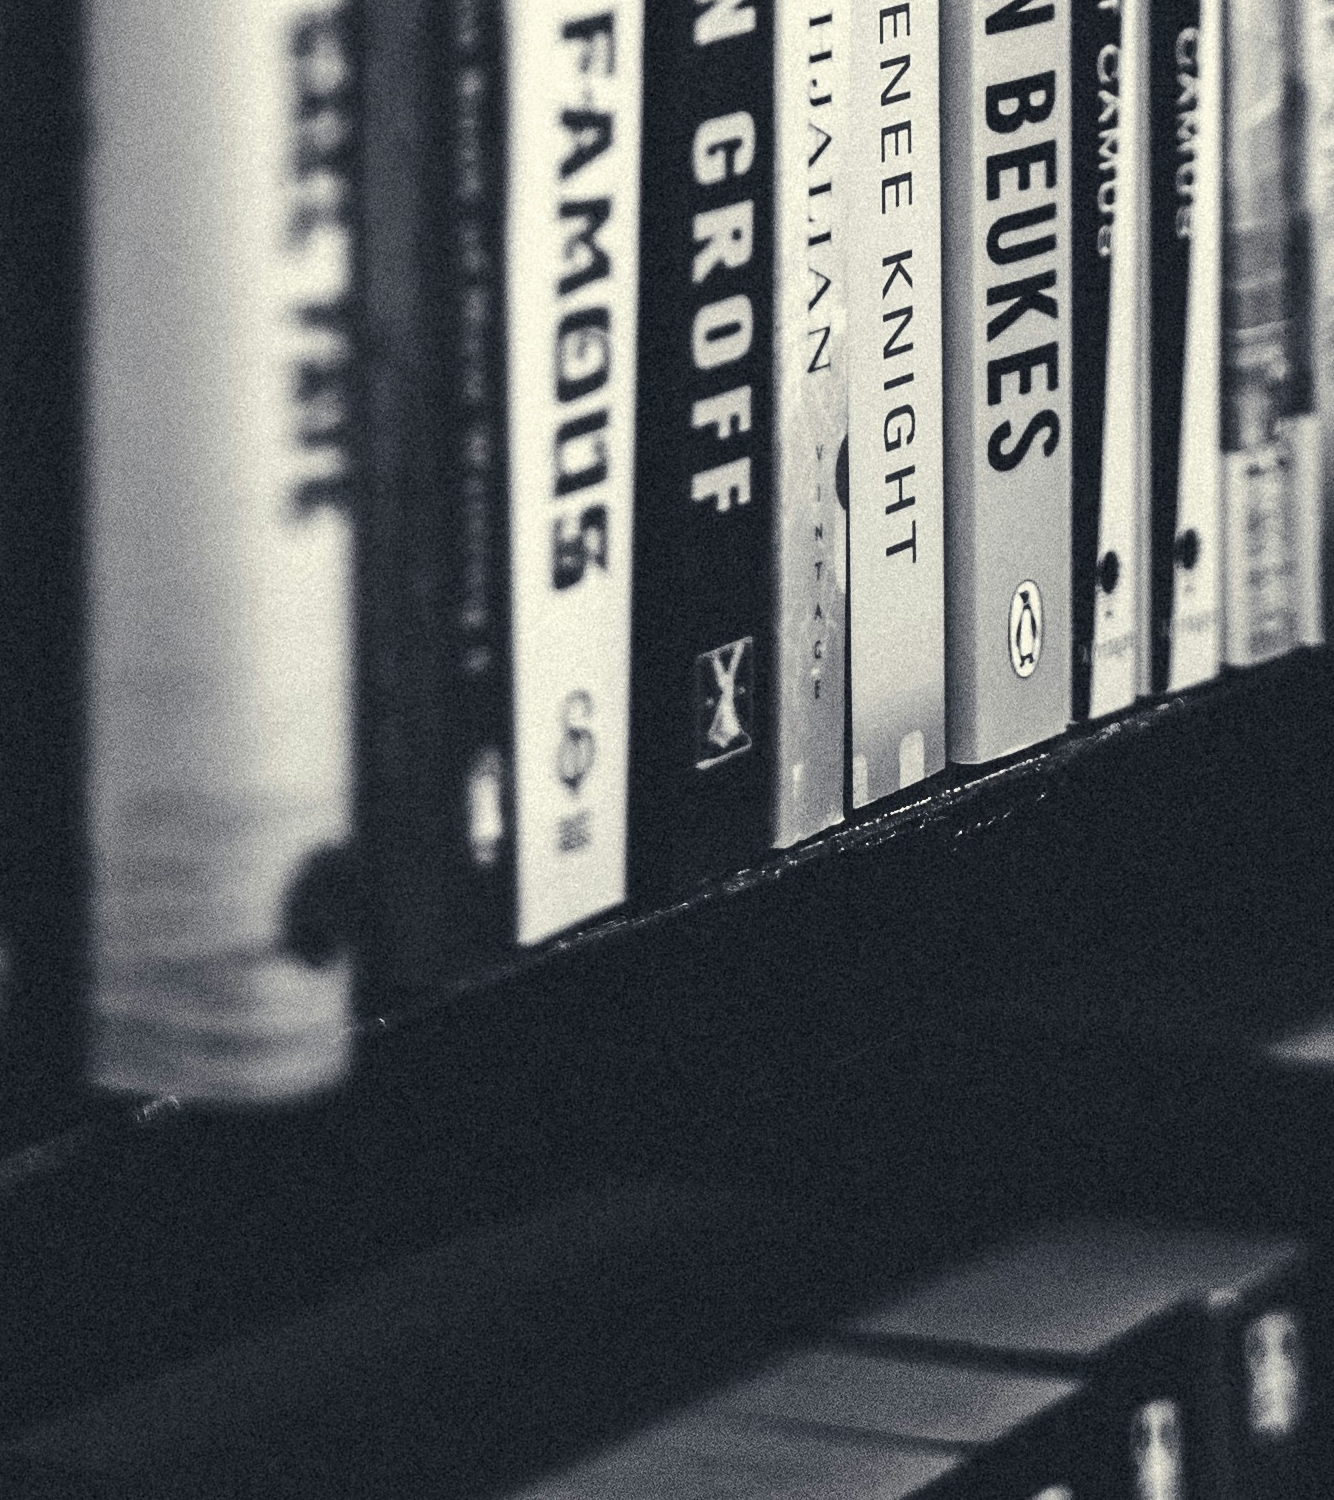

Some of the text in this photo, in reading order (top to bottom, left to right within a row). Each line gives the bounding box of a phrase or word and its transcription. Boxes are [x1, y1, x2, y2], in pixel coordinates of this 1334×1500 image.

[549, 5, 619, 596] FAMOUS
[690, 109, 758, 515] GROFF
[984, 69, 1061, 476] BEUKES
[1095, 44, 1124, 260] CAMUS
[1174, 27, 1203, 243] CAMUS
[879, 249, 918, 565] KNIGHT
